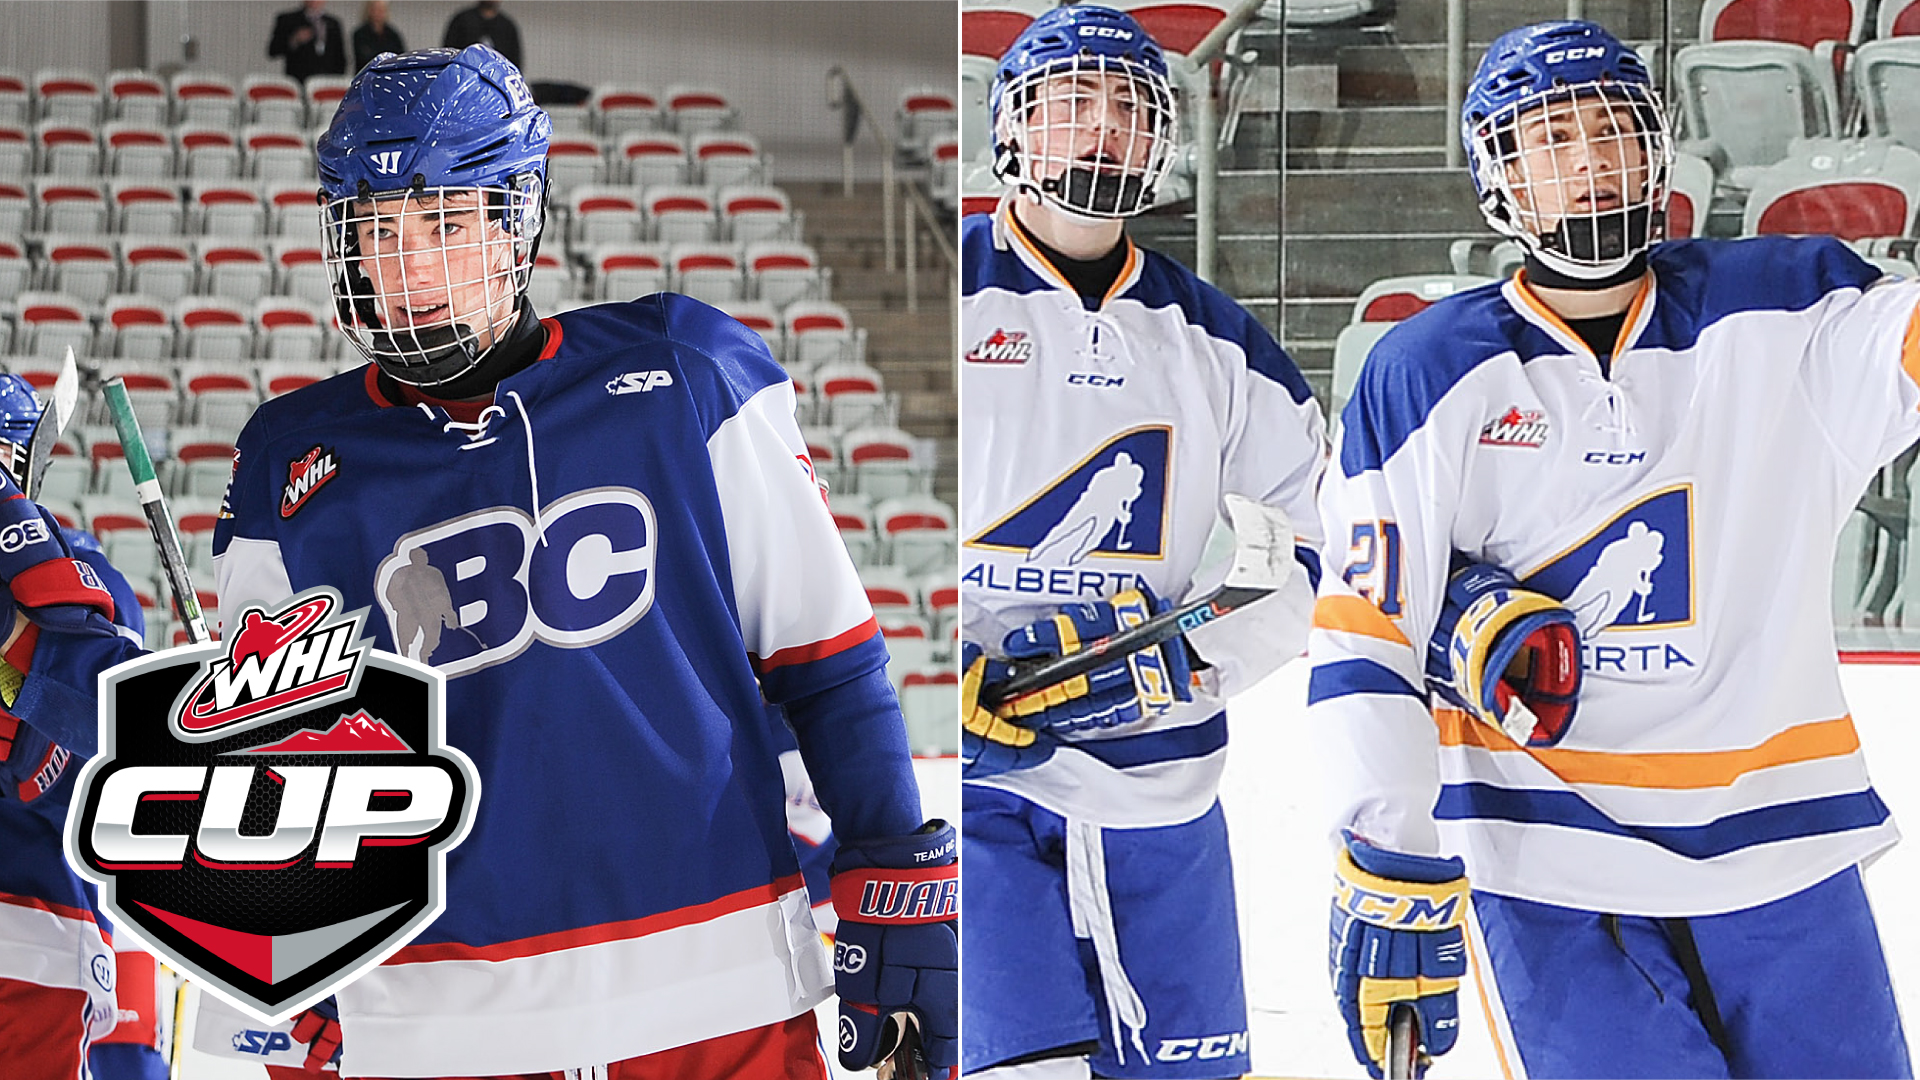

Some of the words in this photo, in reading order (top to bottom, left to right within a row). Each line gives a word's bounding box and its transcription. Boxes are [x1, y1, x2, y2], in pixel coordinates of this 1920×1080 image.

[1078, 25, 1133, 41] CCM
[1545, 47, 1605, 64] CCM
[616, 370, 674, 395] SP
[1067, 373, 1125, 388] CCM
[1490, 420, 1547, 443] WHL
[1583, 452, 1647, 465] CCM
[284, 453, 338, 505] WHL
[1342, 518, 1404, 619] 21
[400, 490, 655, 674] BC
[914, 846, 944, 863] TEAM
[945, 838, 955, 853] BC
[858, 878, 958, 918] WAR
[834, 941, 867, 973] BC
[237, 1029, 292, 1056] SP
[1155, 1030, 1248, 1063] CCM
